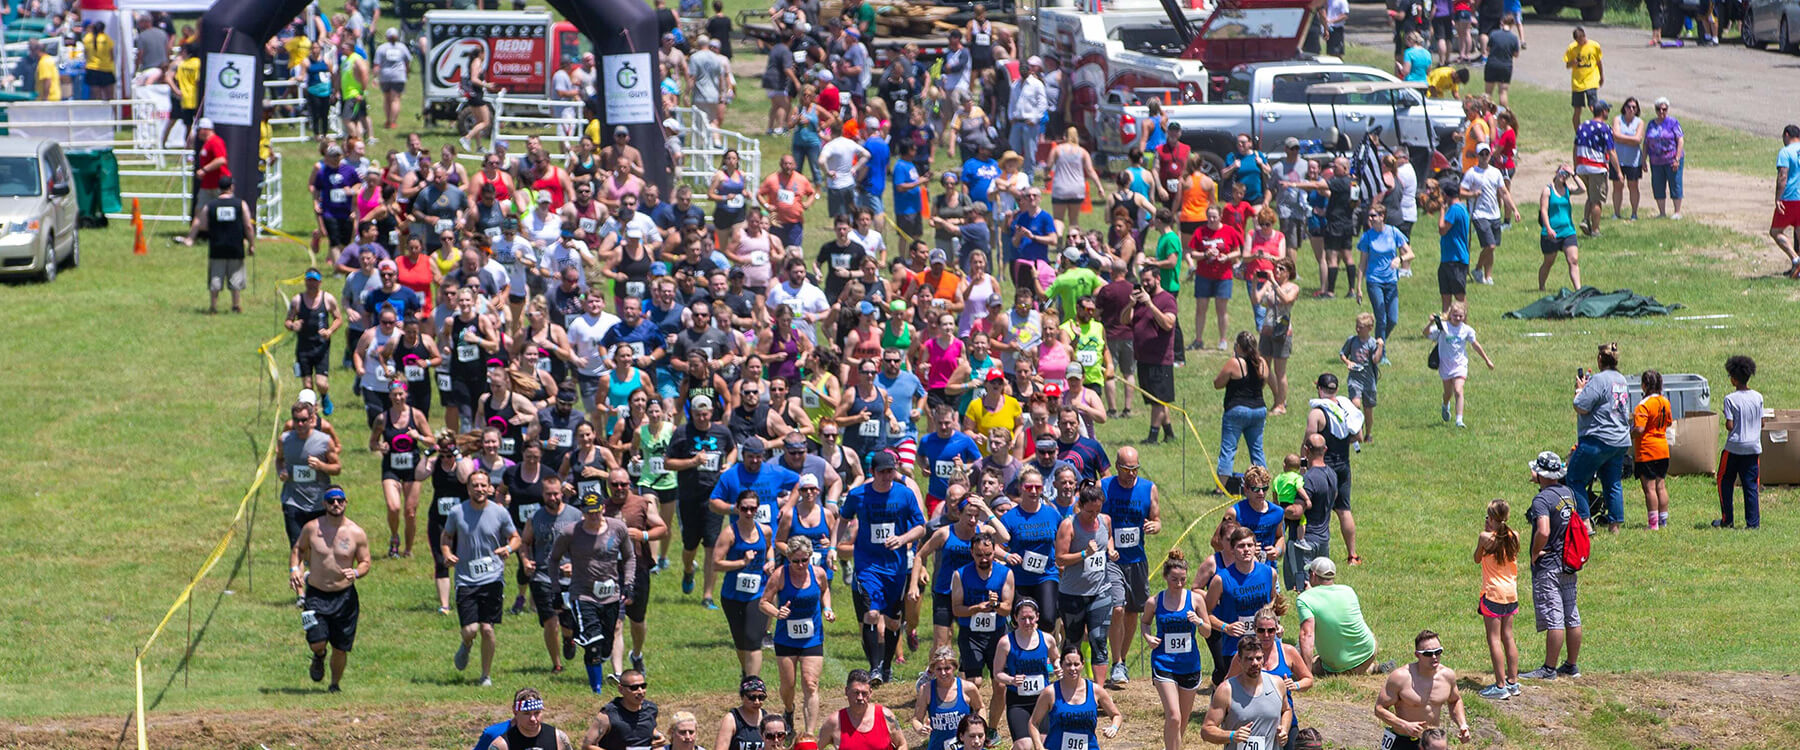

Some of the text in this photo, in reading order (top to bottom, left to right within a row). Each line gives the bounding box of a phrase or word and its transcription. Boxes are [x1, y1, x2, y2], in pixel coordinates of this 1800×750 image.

[495, 40, 534, 52] REDDI
[875, 528, 890, 539] 912
[1120, 533, 1135, 544] 899
[1027, 556, 1042, 568] 913
[1090, 556, 1104, 568] 749
[742, 578, 756, 589] 915
[1233, 584, 1266, 596] COMMIT
[975, 617, 991, 628] 949
[1244, 621, 1255, 631] 93
[793, 624, 808, 634] 919
[1170, 638, 1186, 649] 934
[1023, 680, 1039, 691] 914
[1060, 711, 1095, 720] COMMIT
[1067, 738, 1083, 749] 916
